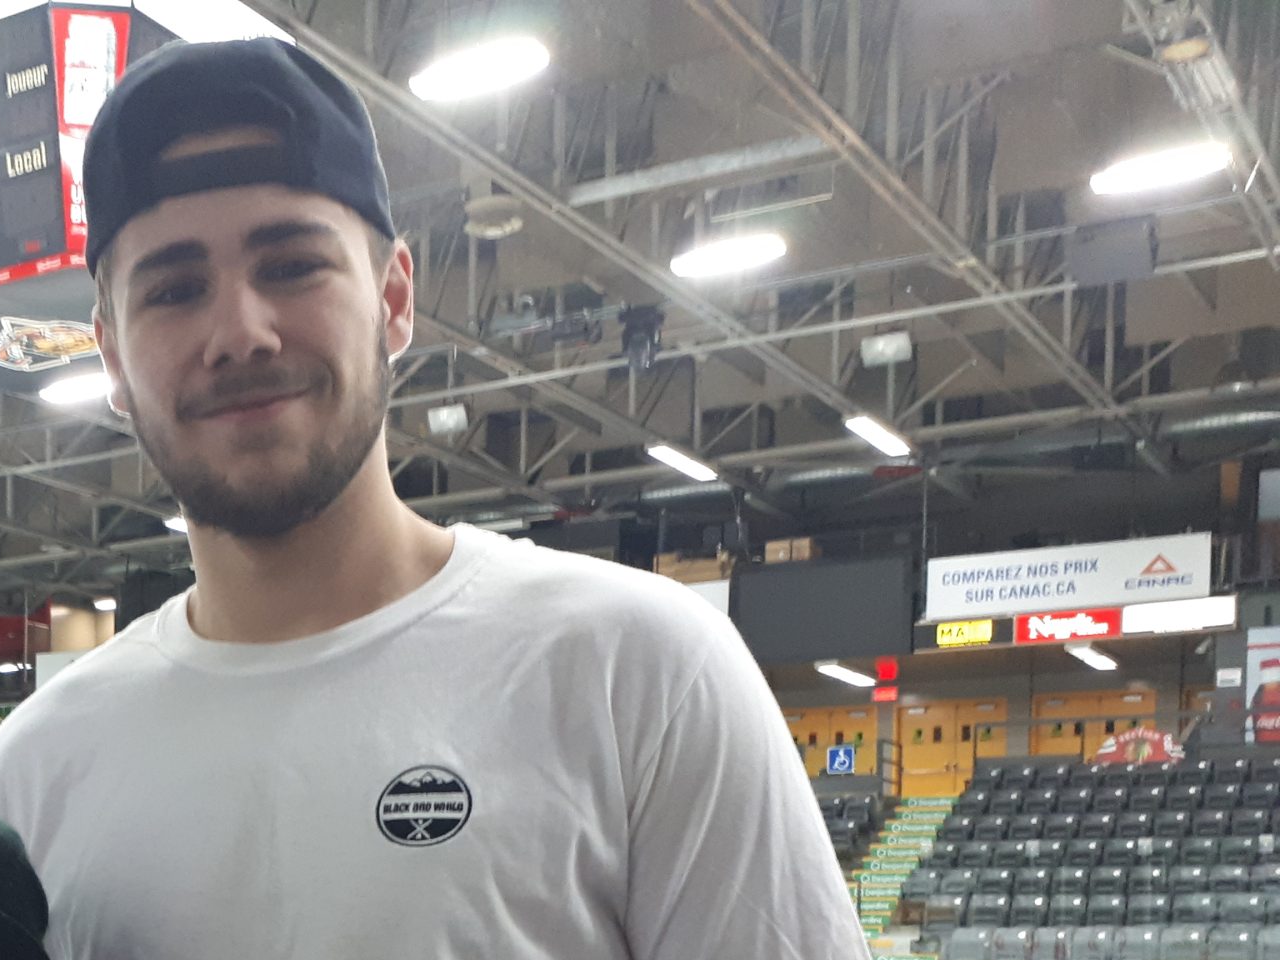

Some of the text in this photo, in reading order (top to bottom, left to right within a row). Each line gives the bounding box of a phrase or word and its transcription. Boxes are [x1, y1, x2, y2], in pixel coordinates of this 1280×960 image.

[6, 141, 48, 178] Local
[942, 558, 1099, 587] COMPAREZ NOS PRIX
[965, 580, 1077, 603] SUR CANAC.CA
[383, 803, 410, 815] BLACK
